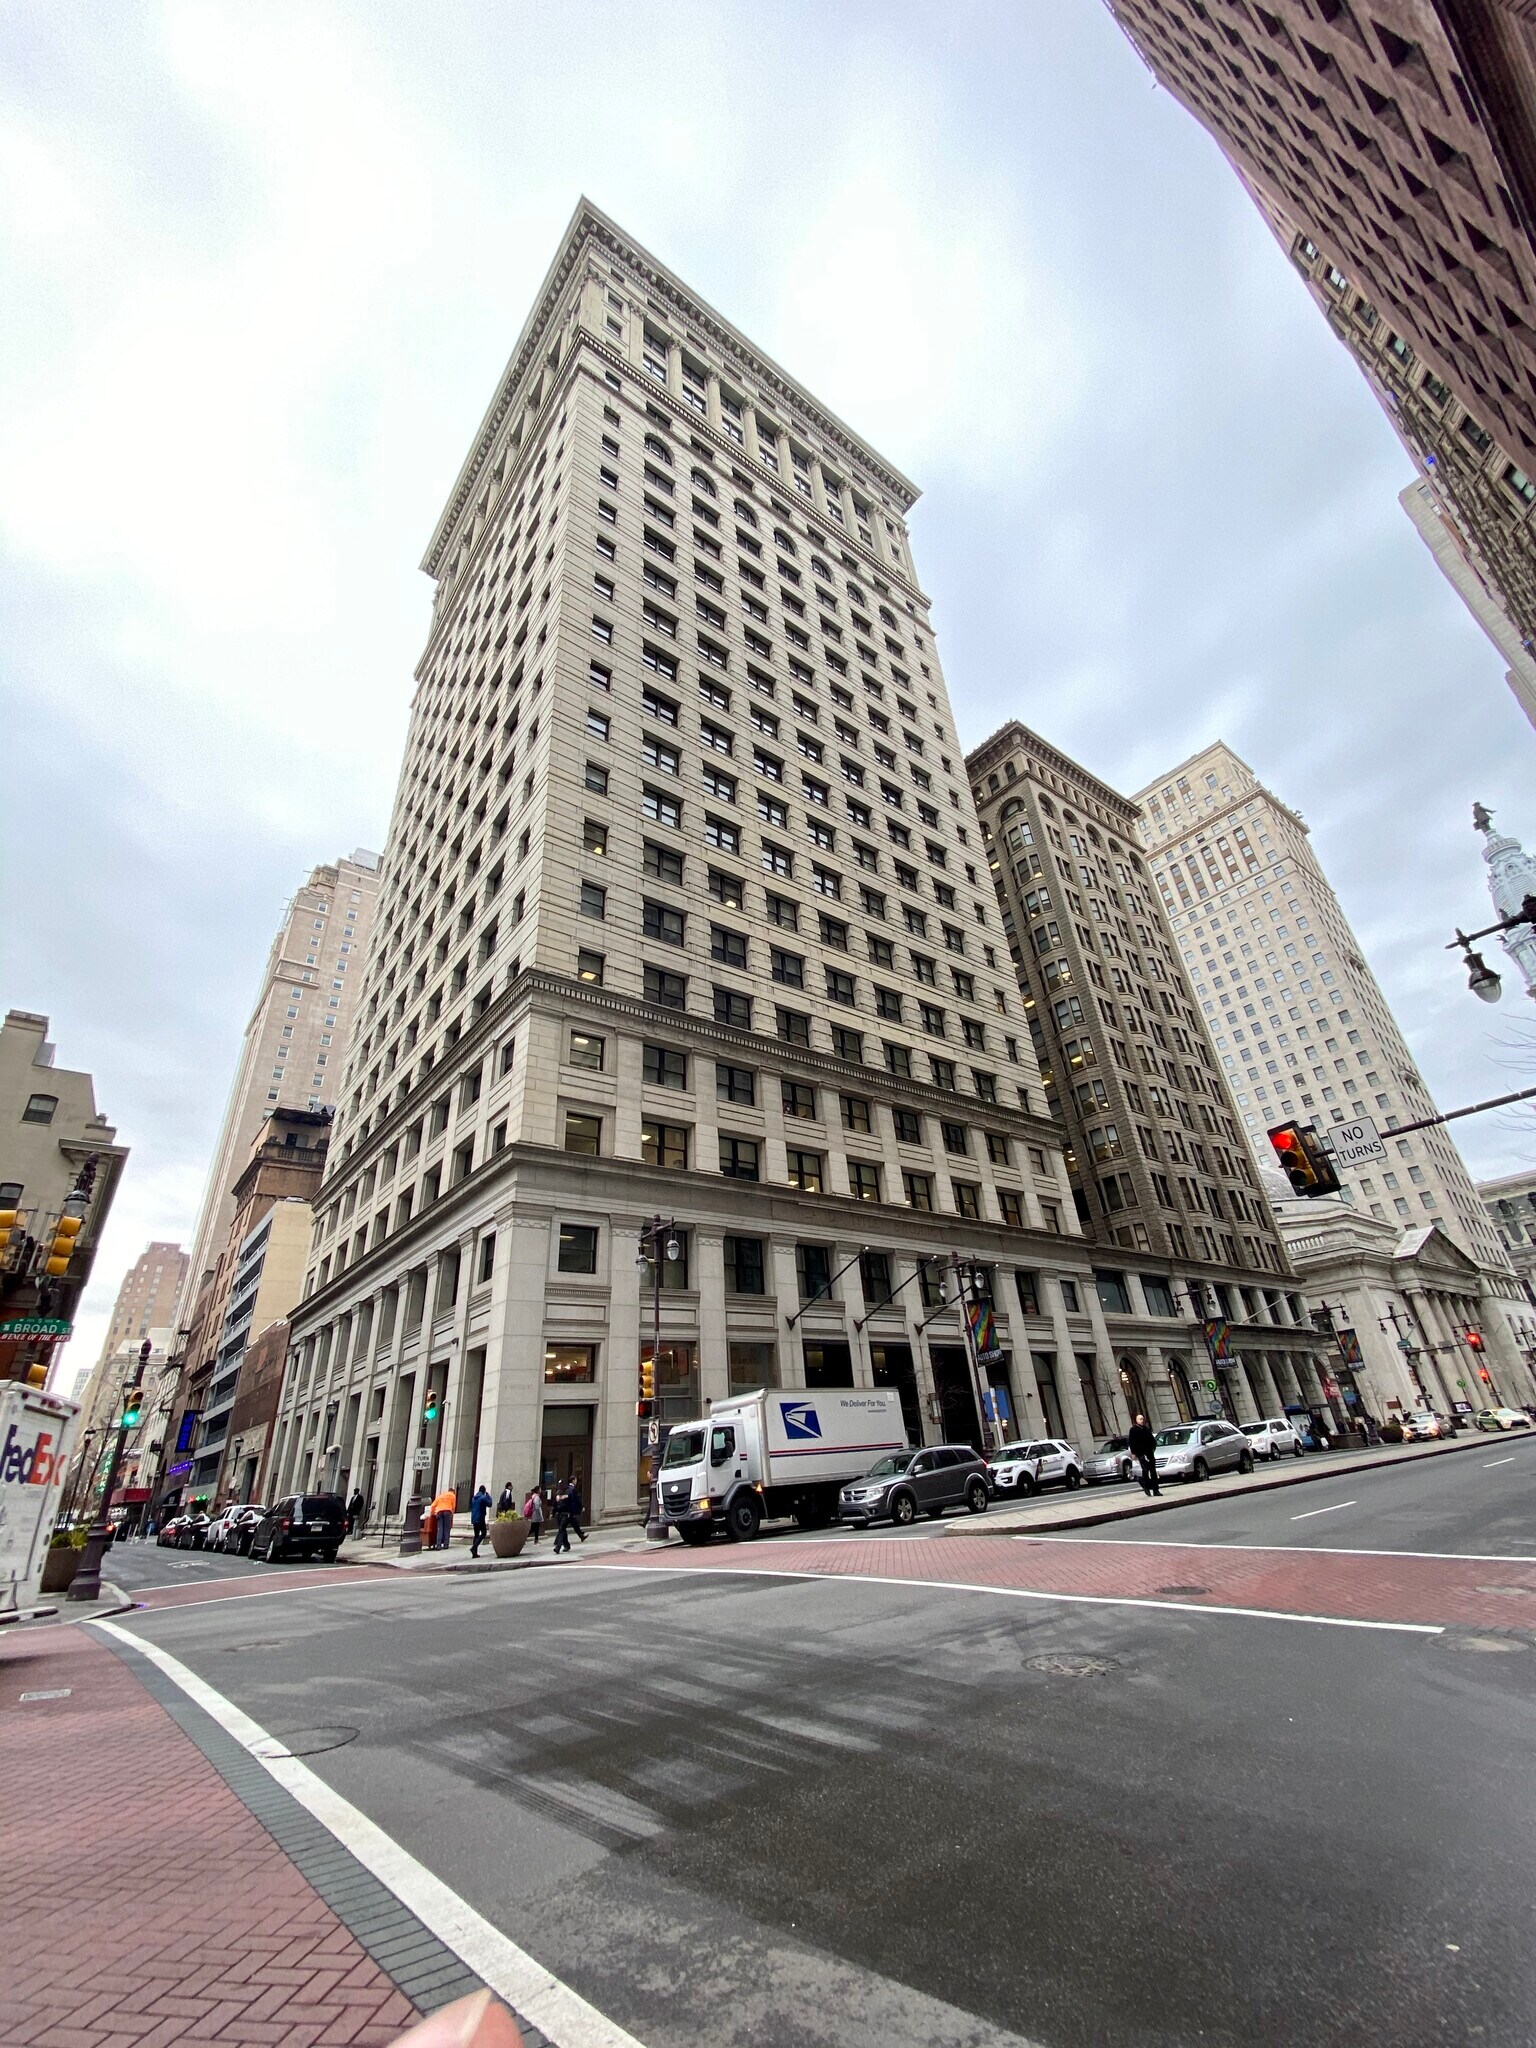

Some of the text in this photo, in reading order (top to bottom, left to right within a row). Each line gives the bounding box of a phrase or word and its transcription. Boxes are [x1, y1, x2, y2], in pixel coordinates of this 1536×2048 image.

[1341, 1126, 1364, 1143] NO
[1339, 1141, 1382, 1162] TURNS
[13, 1323, 58, 1334] BROAD
[840, 1399, 849, 1407] We
[849, 1399, 867, 1407] Deliver
[867, 1399, 876, 1407] For
[0, 1424, 66, 1486] FedEx
